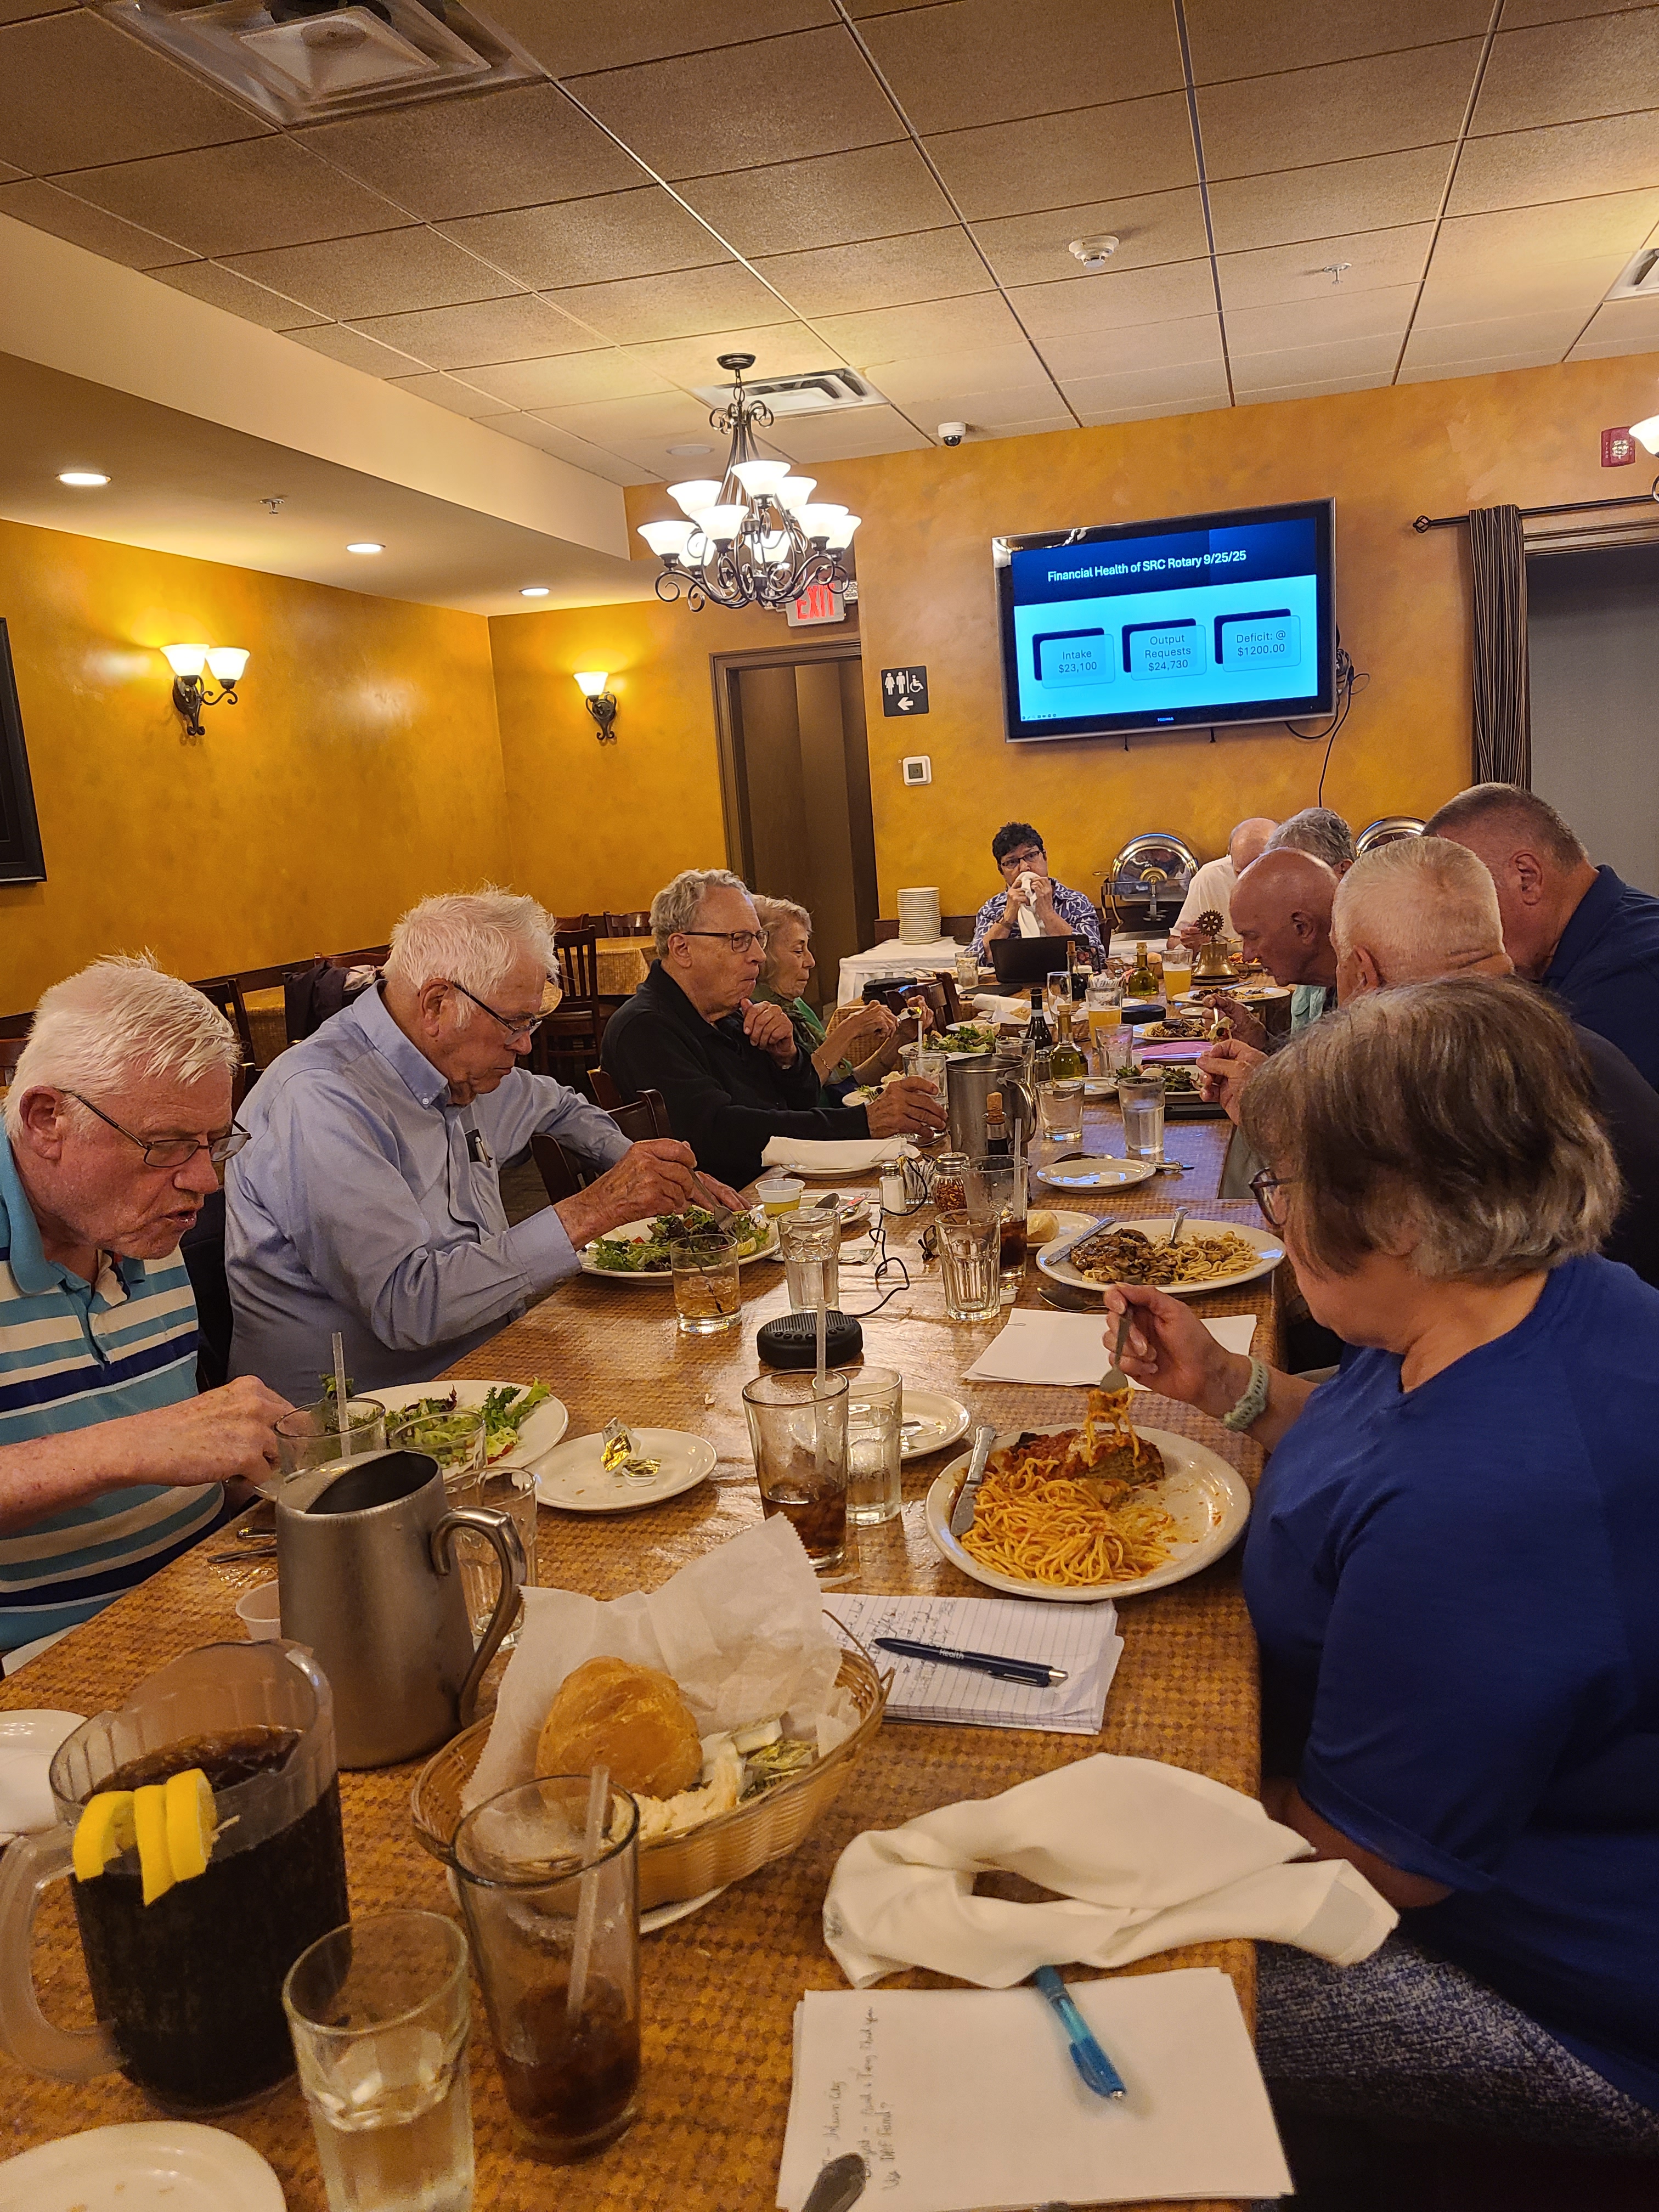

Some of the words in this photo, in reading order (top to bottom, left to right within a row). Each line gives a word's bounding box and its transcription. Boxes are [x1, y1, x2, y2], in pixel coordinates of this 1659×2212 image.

[1048, 567, 1093, 582] Financial
[1095, 563, 1128, 577] Health
[1130, 561, 1142, 573] of
[1143, 559, 1166, 572] SRC
[1168, 556, 1202, 568] Rotary
[1203, 550, 1246, 565] 9/25/25
[795, 583, 835, 620] EXIT
[1150, 635, 1185, 645] Output
[1237, 632, 1272, 643] Deficit:
[1276, 630, 1286, 640] @
[1062, 650, 1092, 660] Intake
[1145, 647, 1191, 659] Requests
[1238, 644, 1285, 657] $1200.00
[1058, 662, 1097, 673] $23,100
[1148, 659, 1188, 672] $24,730
